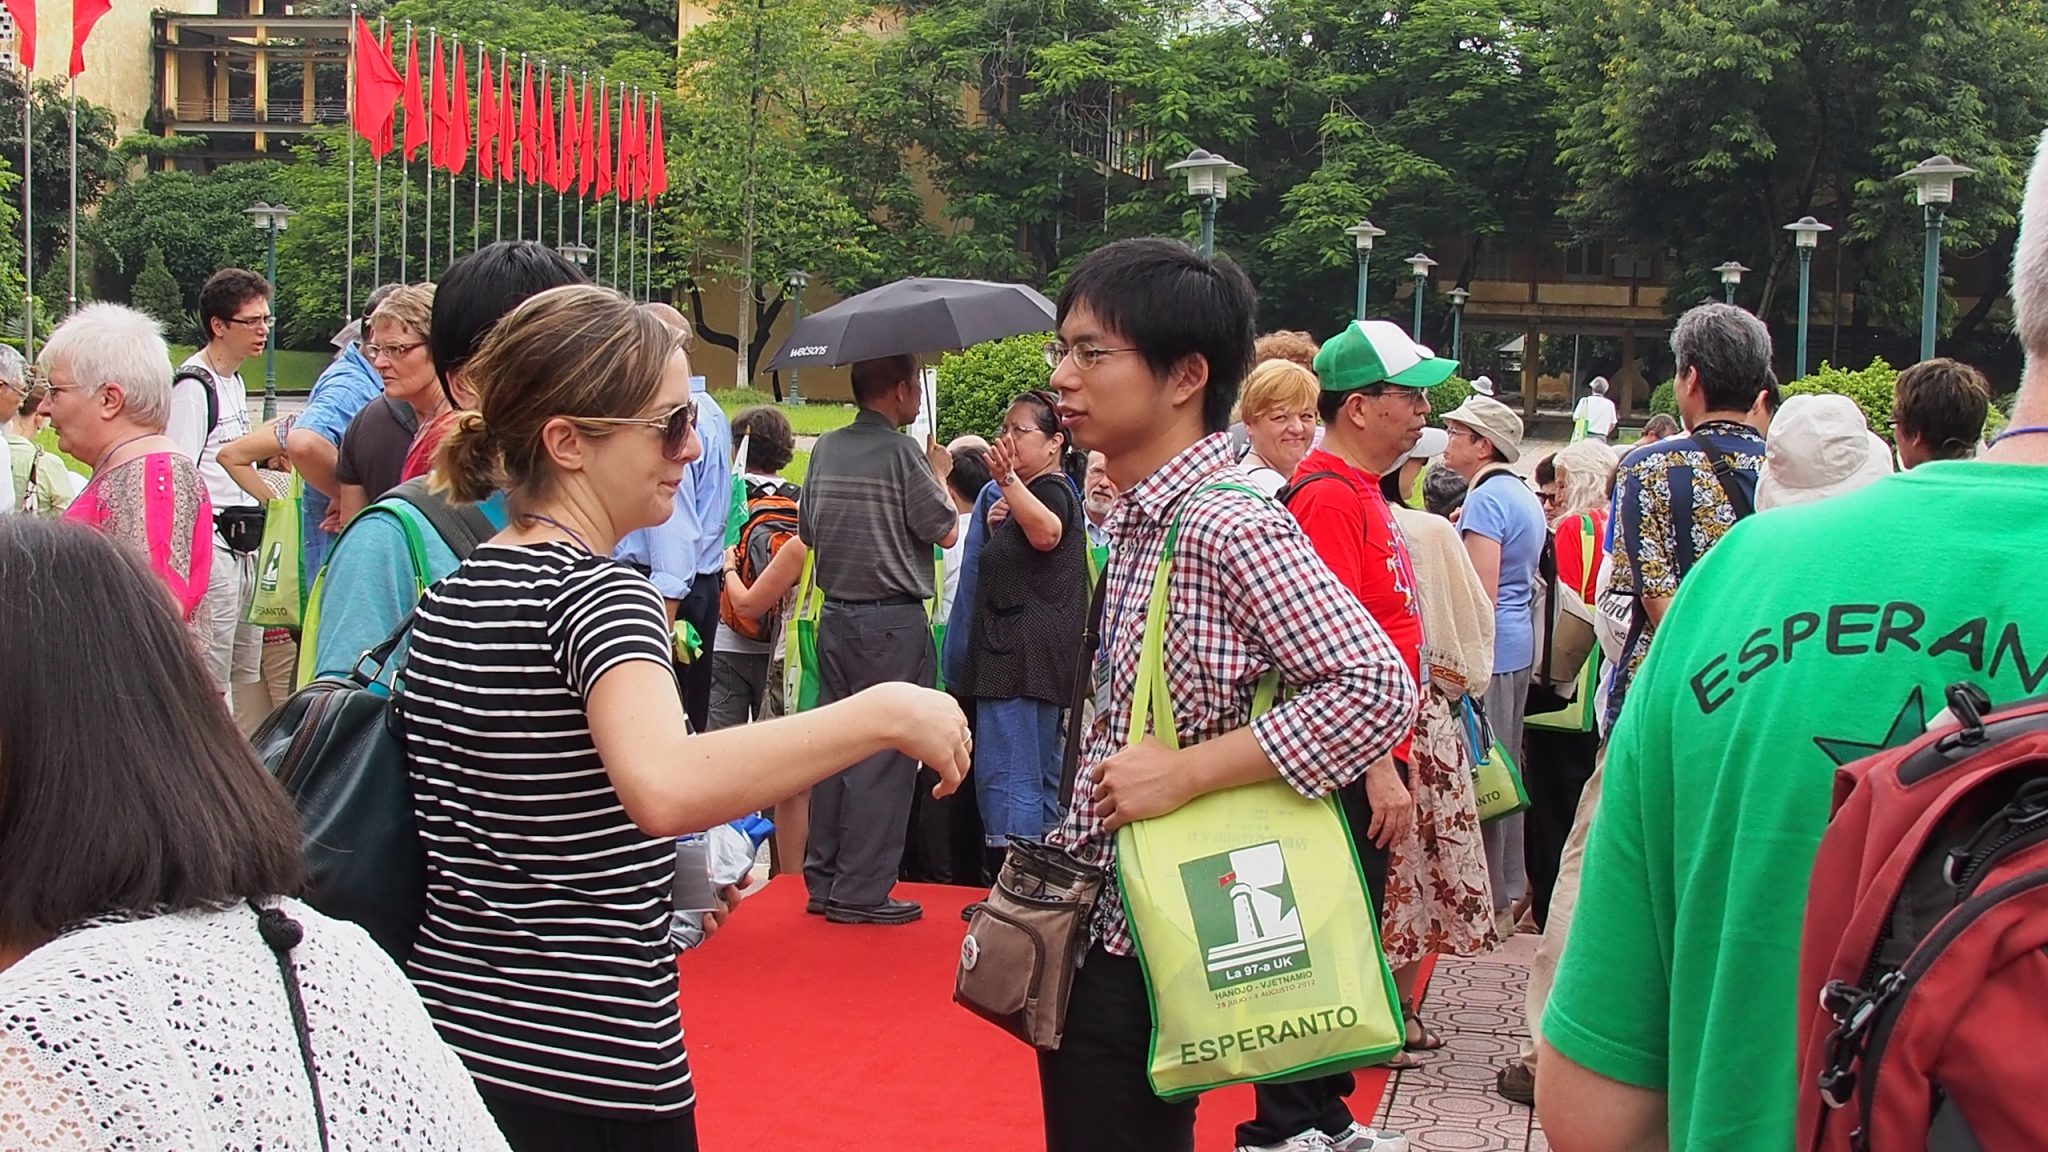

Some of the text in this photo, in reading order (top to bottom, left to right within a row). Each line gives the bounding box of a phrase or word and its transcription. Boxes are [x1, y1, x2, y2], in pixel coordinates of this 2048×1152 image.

[789, 345, 828, 358] watsons
[1689, 601, 2048, 715] ESPERAN
[1225, 956, 1294, 981] La 97-a UK
[1215, 984, 1253, 1000] HANOJO
[1260, 970, 1313, 989] VJETNAMIO
[1261, 984, 1296, 998] AUGUSTO
[1297, 979, 1316, 989] 2012
[1180, 1005, 1358, 1065] ESPERANTO
